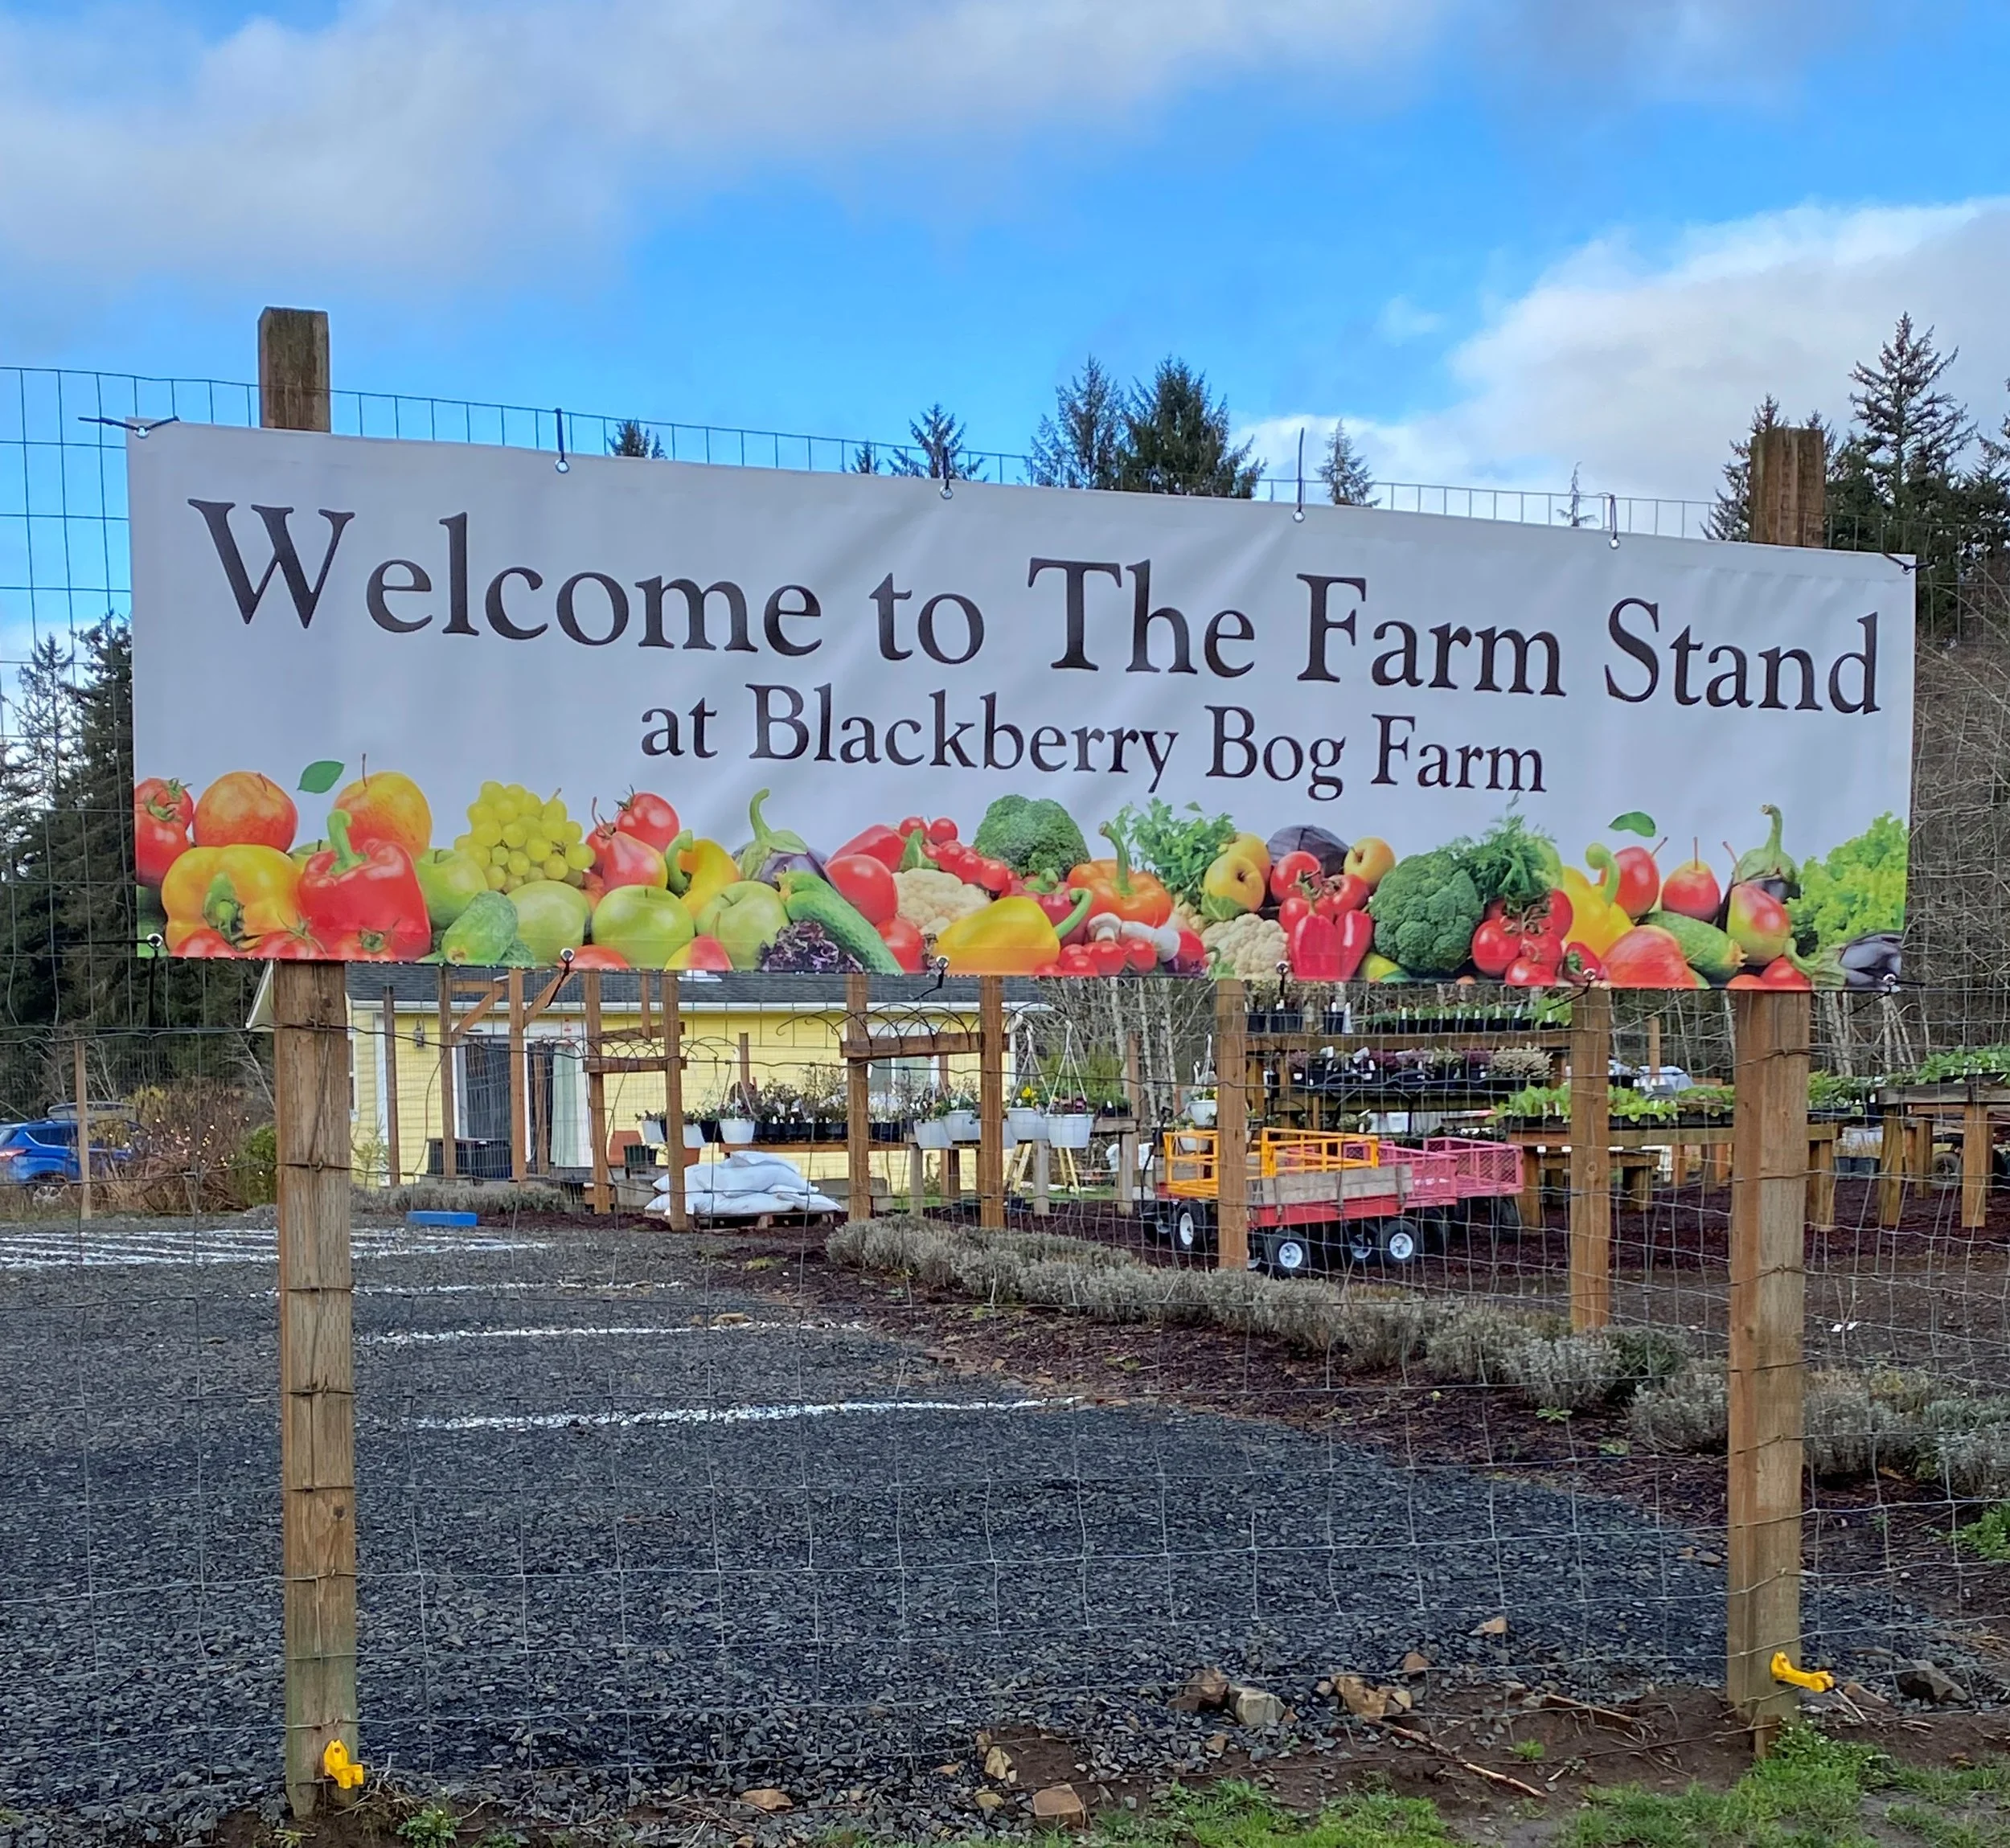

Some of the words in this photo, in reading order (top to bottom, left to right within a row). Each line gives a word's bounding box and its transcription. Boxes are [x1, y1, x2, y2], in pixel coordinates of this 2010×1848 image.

[188, 499, 822, 656] Welcome
[869, 572, 984, 665] to
[1028, 558, 1254, 678] The
[1297, 574, 1567, 698] Farm
[1605, 597, 1881, 715] Stand
[642, 697, 718, 759] at
[745, 683, 1179, 793] Blackberry
[1204, 705, 1346, 801] Bog
[1371, 713, 1547, 793] Farm
